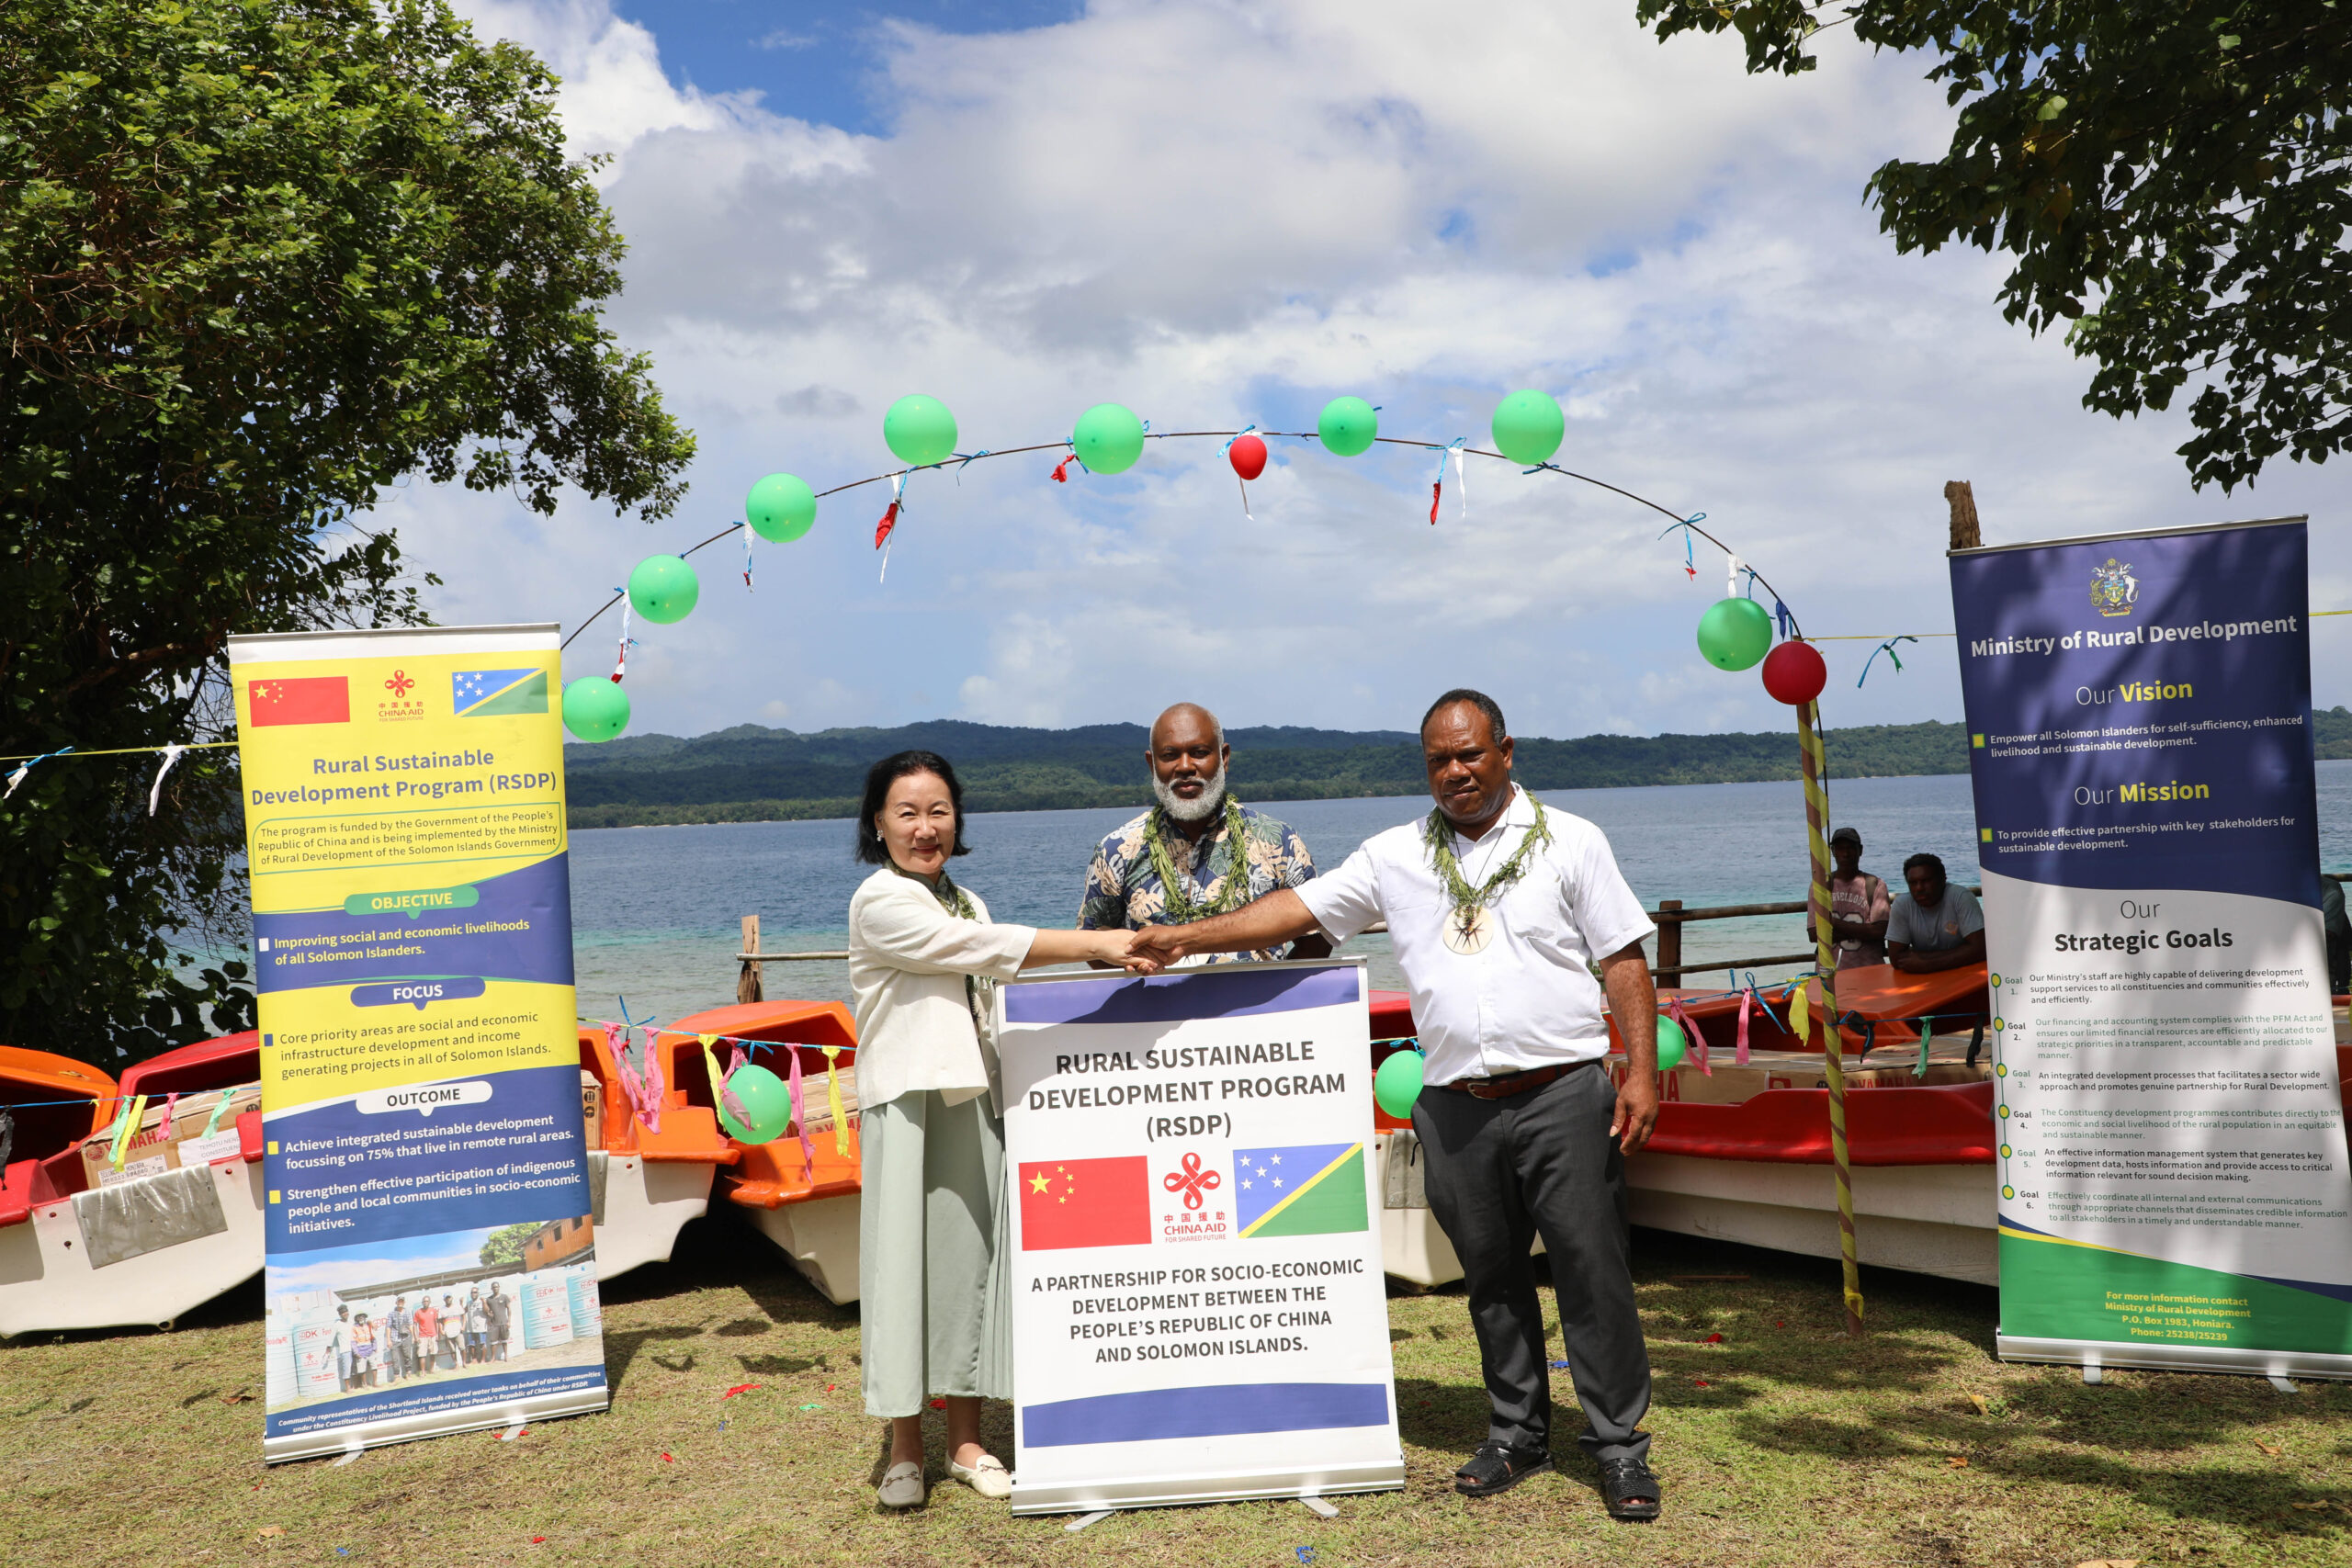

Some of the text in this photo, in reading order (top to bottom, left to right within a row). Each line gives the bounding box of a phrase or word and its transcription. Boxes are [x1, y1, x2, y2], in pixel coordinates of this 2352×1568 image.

[1972, 615, 2297, 657] Ministry of Rural Development
[2076, 680, 2192, 705] Our Vision
[1991, 715, 2301, 744] Empower all Solomon Islanders for self-sufficiency, enhanced
[1992, 737, 2196, 757] livelihood and sustainable development.
[313, 750, 493, 774] Rural Sustainable
[253, 772, 556, 806] Development Program (RSDP)
[2075, 781, 2209, 805] Our Mission
[1998, 816, 2294, 840] To provide effective partnership with key stakeholders for
[1999, 839, 2128, 852] sustainable development.
[371, 893, 452, 909] OBJECTIVE
[2120, 900, 2160, 919] Our
[275, 919, 529, 950] Improving social and economic livelihoods
[2055, 928, 2233, 953] Strategic Goals
[276, 944, 424, 965] of all Solomon Islanders.
[2031, 986, 2062, 994] support
[2123, 982, 2184, 990] constituencies
[2265, 979, 2309, 988] effectively
[2047, 973, 2086, 982] Ministry's
[2125, 971, 2150, 981] highly
[2154, 971, 2186, 980] capable
[2199, 970, 2243, 978] delivering
[2245, 968, 2302, 977] development
[393, 985, 443, 1000] FOCUS
[2049, 996, 2092, 1004] efficiently.
[280, 1012, 537, 1043] Core priority areas are social and economic
[281, 1032, 520, 1061] infrastructure development and income
[1057, 1041, 1314, 1074] RURAL SUSTAINABLE
[282, 1043, 550, 1080] generating projects in all of Solomon Islands.
[387, 1089, 460, 1107] OUTCOME
[1030, 1074, 1345, 1110] DEVELOPMENT PROGRAM
[286, 1115, 553, 1153] Achieve integrated sustainable development
[1147, 1112, 1231, 1142] (RSDP)
[1164, 1211, 1225, 1224] 中国援助
[1164, 1223, 1226, 1235] CHINA AID
[1032, 1258, 1363, 1292] A PARTNERSHIP FOR SOCIO-ECONOMIC
[1073, 1286, 1326, 1314] DEVELOPMENT BETWEEN THE
[2106, 1303, 2143, 1314] Ministry
[2158, 1305, 2183, 1314] Rural
[2186, 1306, 2251, 1317] Development
[2107, 1292, 2122, 1300] For
[2152, 1293, 2209, 1303] information
[2211, 1298, 2248, 1306] contact
[1160, 1315, 1245, 1334] REPUBLIC
[1250, 1314, 1272, 1328] OF
[1278, 1311, 1331, 1326] CHINA
[2122, 1315, 2234, 1329] P.O. Box 1983, Honiara.
[2132, 1328, 2227, 1340] Phone: 25238/25239
[1096, 1337, 1307, 1363] AND SOLOMON ISLANDS.
